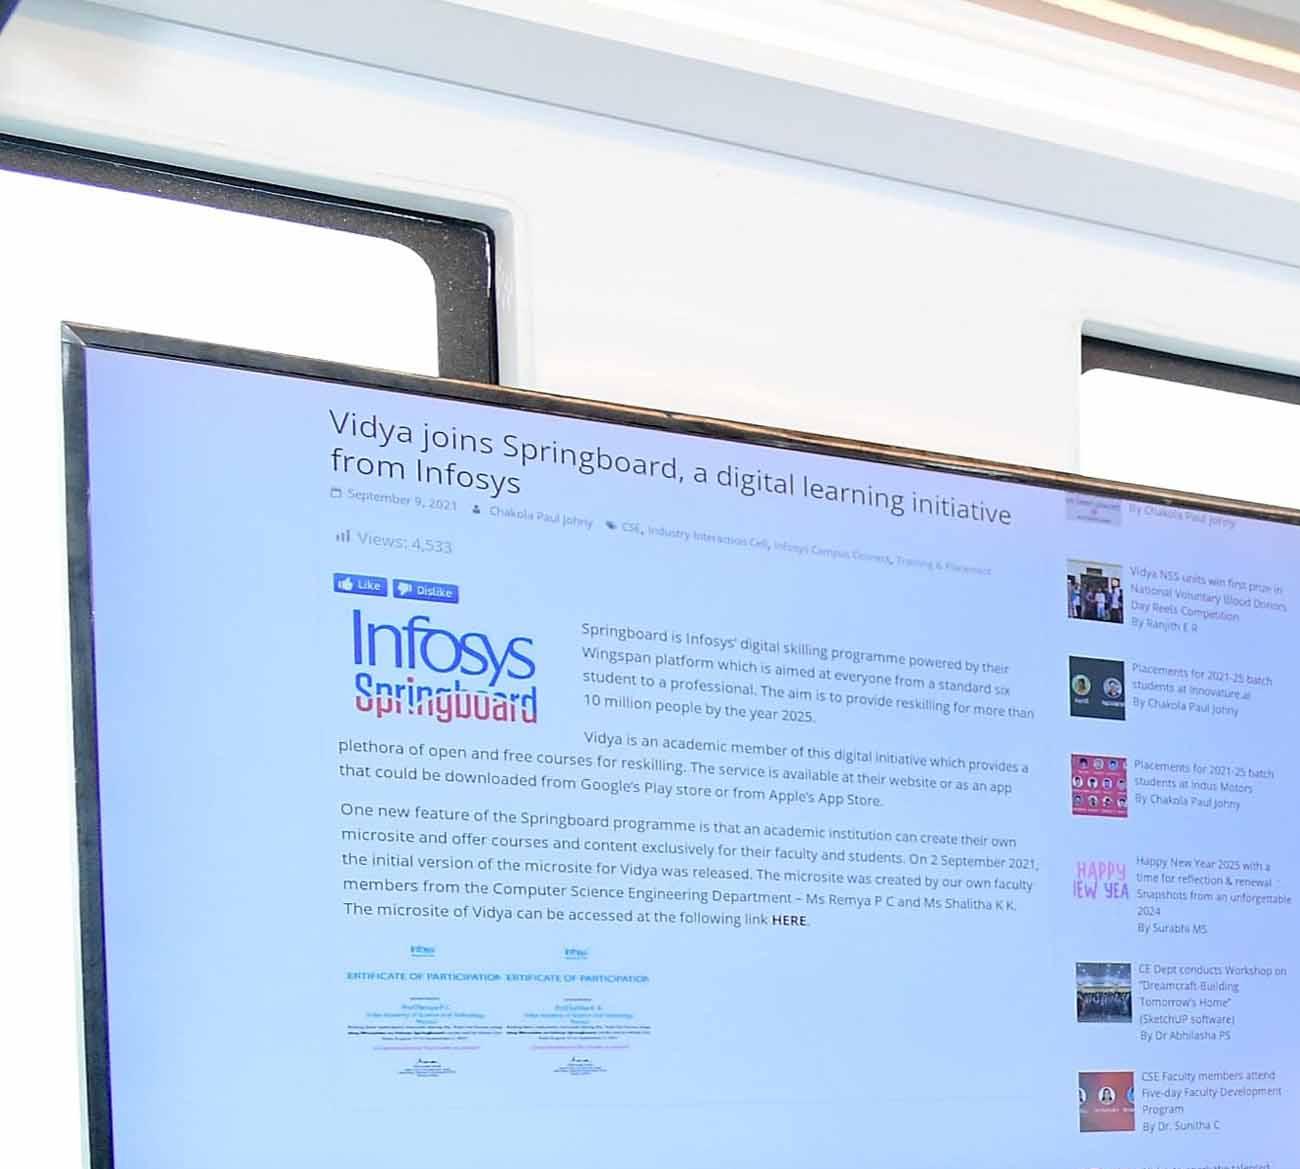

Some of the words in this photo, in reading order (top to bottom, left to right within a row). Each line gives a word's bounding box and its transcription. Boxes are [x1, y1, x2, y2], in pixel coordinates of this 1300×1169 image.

[328, 409, 413, 450] Vidya
[420, 422, 494, 454] joins
[503, 434, 684, 484] Springboard,
[693, 467, 708, 484] a
[716, 465, 794, 497] digital
[803, 475, 905, 517] learning
[912, 491, 1012, 526] initiative
[330, 447, 405, 480] from
[418, 459, 521, 499] Infosys
[347, 487, 412, 506] September
[428, 497, 457, 511] 2021
[357, 532, 408, 550] Views:
[410, 538, 453, 554] 4,533
[358, 580, 383, 592] Like
[416, 585, 454, 599] Dislike
[353, 609, 536, 687] Infosys
[581, 622, 668, 642] Springboard
[671, 632, 683, 645] is
[685, 632, 737, 651] Infosys'
[739, 638, 781, 655] digital
[783, 642, 829, 661] skilling
[830, 649, 906, 665] programme
[908, 656, 963, 671] powered
[964, 659, 980, 675] by
[981, 662, 1009, 674] their
[581, 645, 652, 665] Wingspan
[655, 653, 714, 670] platform
[717, 659, 758, 673] which
[760, 664, 772, 675] is
[774, 665, 816, 679] aimed
[818, 669, 832, 680] at
[833, 672, 893, 687] everyone
[894, 674, 925, 688] from
[928, 680, 936, 689] a
[937, 680, 992, 695] standard
[994, 686, 1010, 697] six
[355, 672, 537, 724] Springboard
[582, 671, 638, 686] student
[640, 675, 656, 687] to
[658, 678, 667, 689] a
[670, 679, 758, 696] professional.
[759, 684, 785, 698] The
[787, 687, 813, 702] aim
[815, 689, 827, 702] is
[828, 692, 843, 704] to
[845, 694, 894, 708] provide
[895, 698, 951, 716] reskilling
[953, 701, 971, 713] for
[973, 705, 1006, 717] more
[1007, 707, 1035, 719] than
[583, 693, 601, 707] 10
[604, 695, 652, 711] million
[655, 701, 703, 717] people
[705, 703, 722, 720] by
[724, 704, 747, 718] the
[748, 709, 779, 722] year
[781, 709, 817, 723] 2025.
[583, 730, 623, 748] Vidya
[626, 736, 638, 747] is
[640, 737, 659, 748] an
[661, 736, 728, 752] academic
[730, 743, 788, 757] member
[790, 746, 805, 758] of
[807, 746, 831, 760] this
[833, 748, 873, 765] digital
[875, 752, 928, 767] initiative
[929, 757, 966, 769] which
[968, 760, 1019, 773] provides
[1021, 764, 1029, 774] a
[338, 763, 372, 778] that
[375, 767, 418, 780] could
[421, 768, 441, 782] be
[444, 769, 537, 788] downloaded
[540, 775, 577, 790] from
[580, 778, 641, 796] Google's
[644, 782, 673, 799] Play
[675, 785, 712, 797] store
[714, 788, 730, 798] or
[732, 786, 766, 800] from
[768, 789, 815, 805] Apple's
[817, 792, 845, 808] App
[847, 794, 883, 807] Store.
[1076, 861, 1127, 880] HAPPY
[343, 902, 374, 916] The
[377, 903, 449, 918] microsite
[453, 905, 470, 918] of
[471, 905, 513, 923] Vidya
[516, 909, 543, 920] can
[546, 907, 565, 920] be
[568, 909, 633, 923] accessed
[636, 911, 651, 922] at
[653, 911, 677, 924] the
[679, 911, 742, 929] following
[744, 913, 769, 925] link
[771, 914, 810, 927] HERE.
